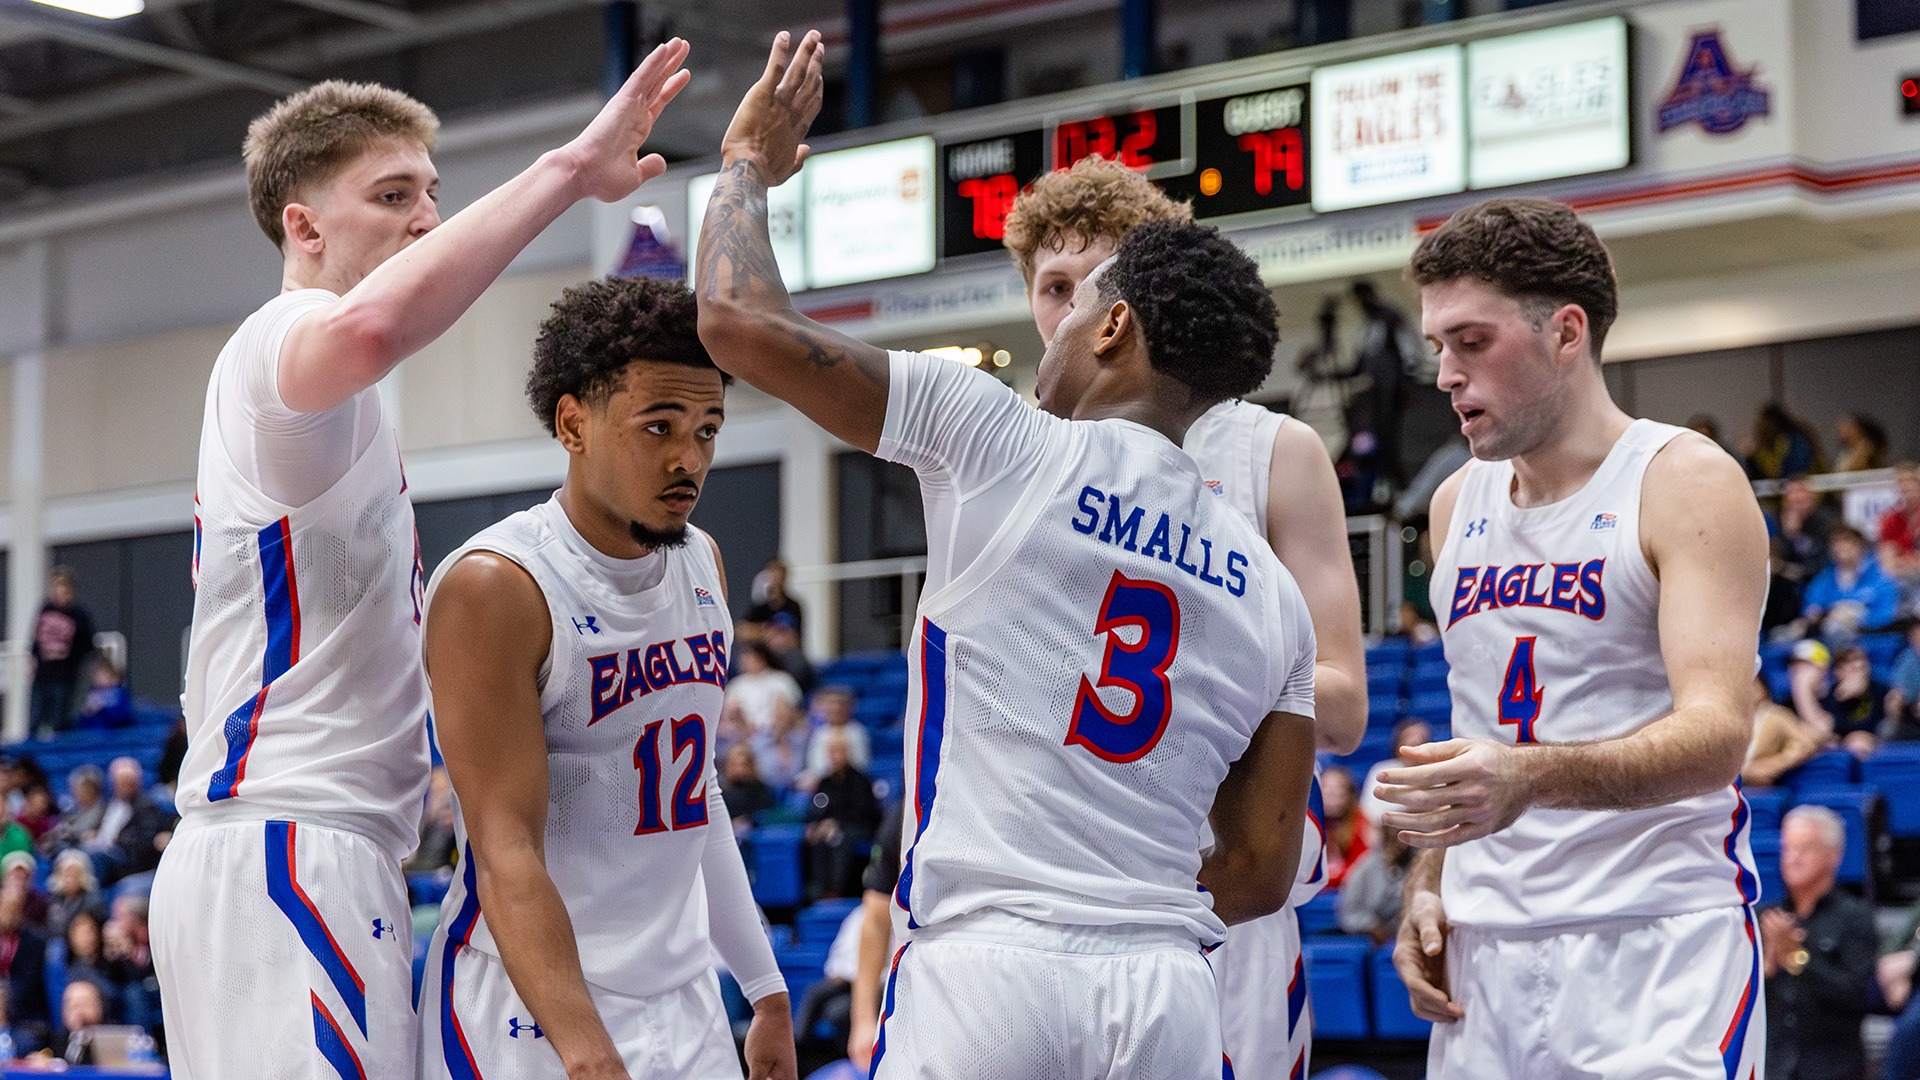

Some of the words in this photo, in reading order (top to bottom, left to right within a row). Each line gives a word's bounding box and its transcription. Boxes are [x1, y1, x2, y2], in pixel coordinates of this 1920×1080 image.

[1223, 87, 1304, 136] GUEST
[951, 138, 1015, 180] HOME
[1240, 128, 1304, 196] 79
[958, 174, 1018, 239] 78
[1071, 485, 1248, 597] SMALLS
[1445, 557, 1606, 632] EAGLES
[587, 630, 727, 727] EAGLES
[1063, 569, 1180, 763] 3
[1498, 636, 1545, 743] 4
[633, 714, 709, 836] 12
